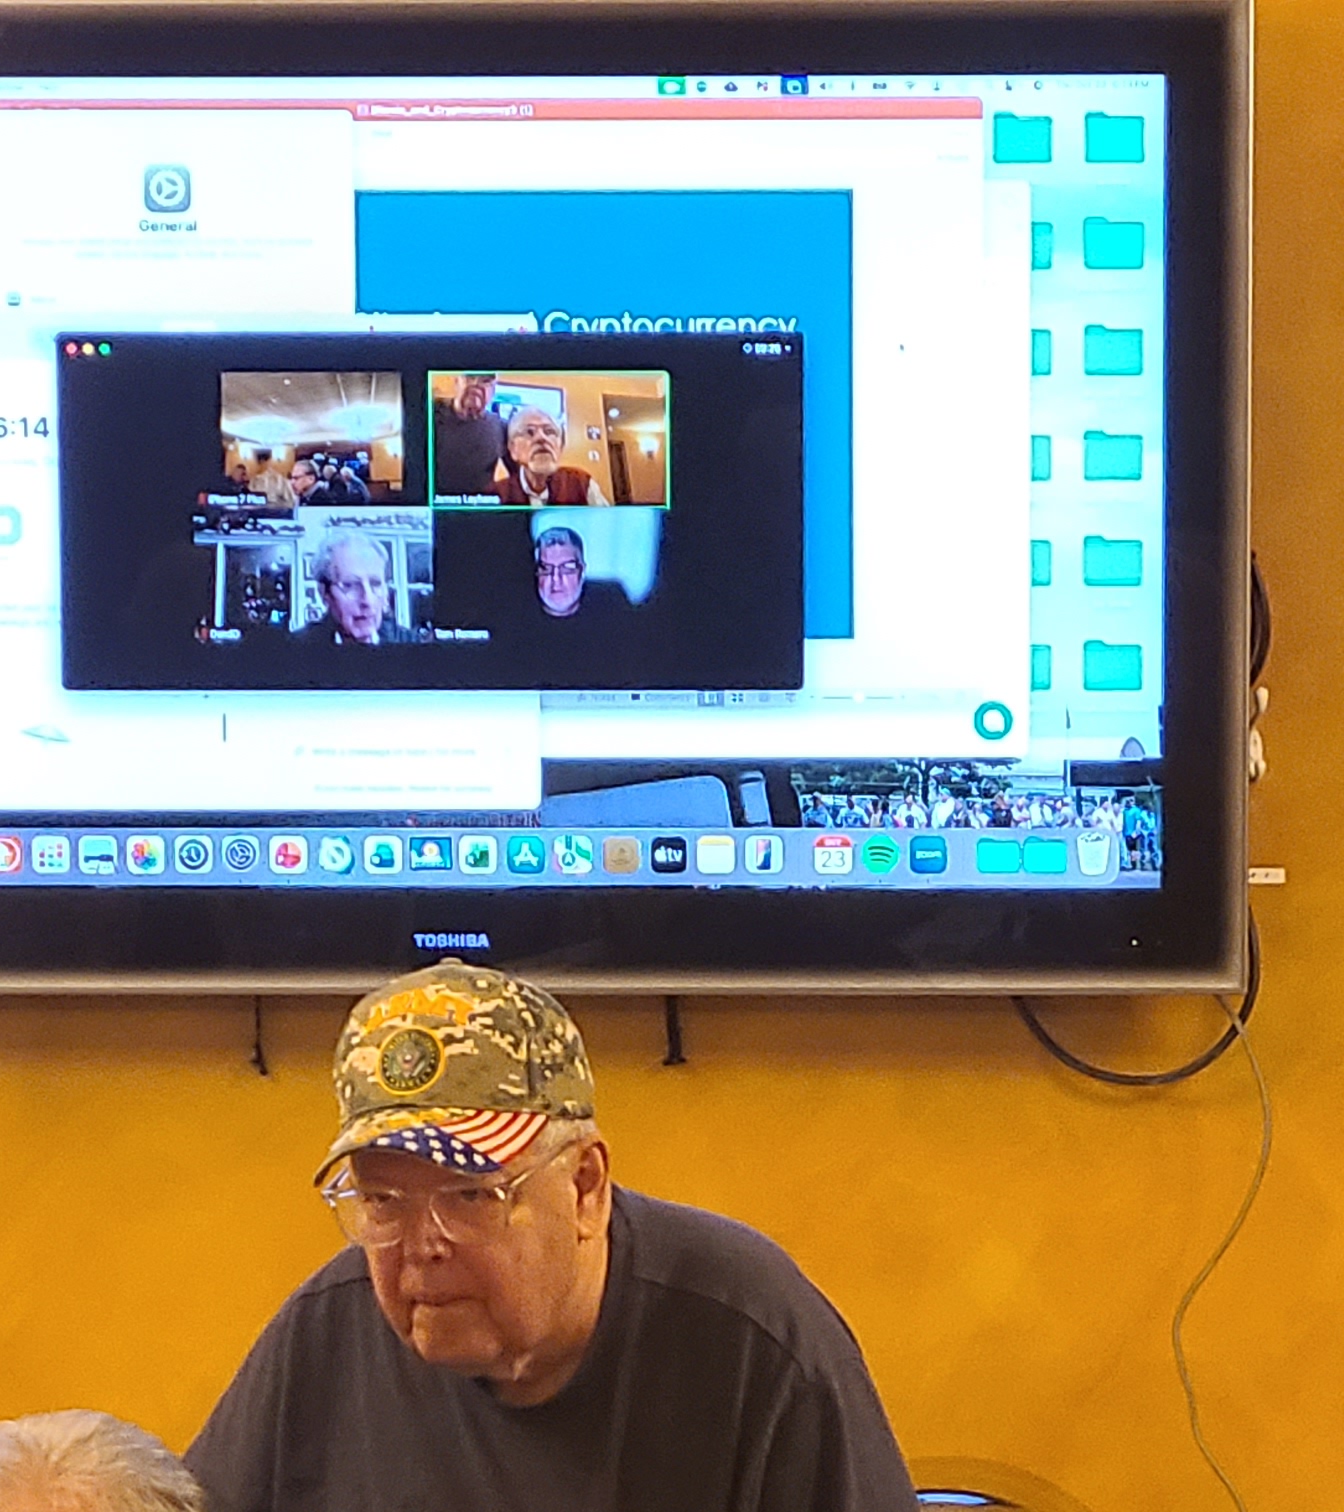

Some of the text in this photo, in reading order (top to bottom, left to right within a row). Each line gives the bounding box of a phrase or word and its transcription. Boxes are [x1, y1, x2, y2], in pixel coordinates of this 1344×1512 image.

[138, 219, 198, 233] General
[820, 850, 846, 868] 23
[413, 933, 490, 948] TOSHIBA
